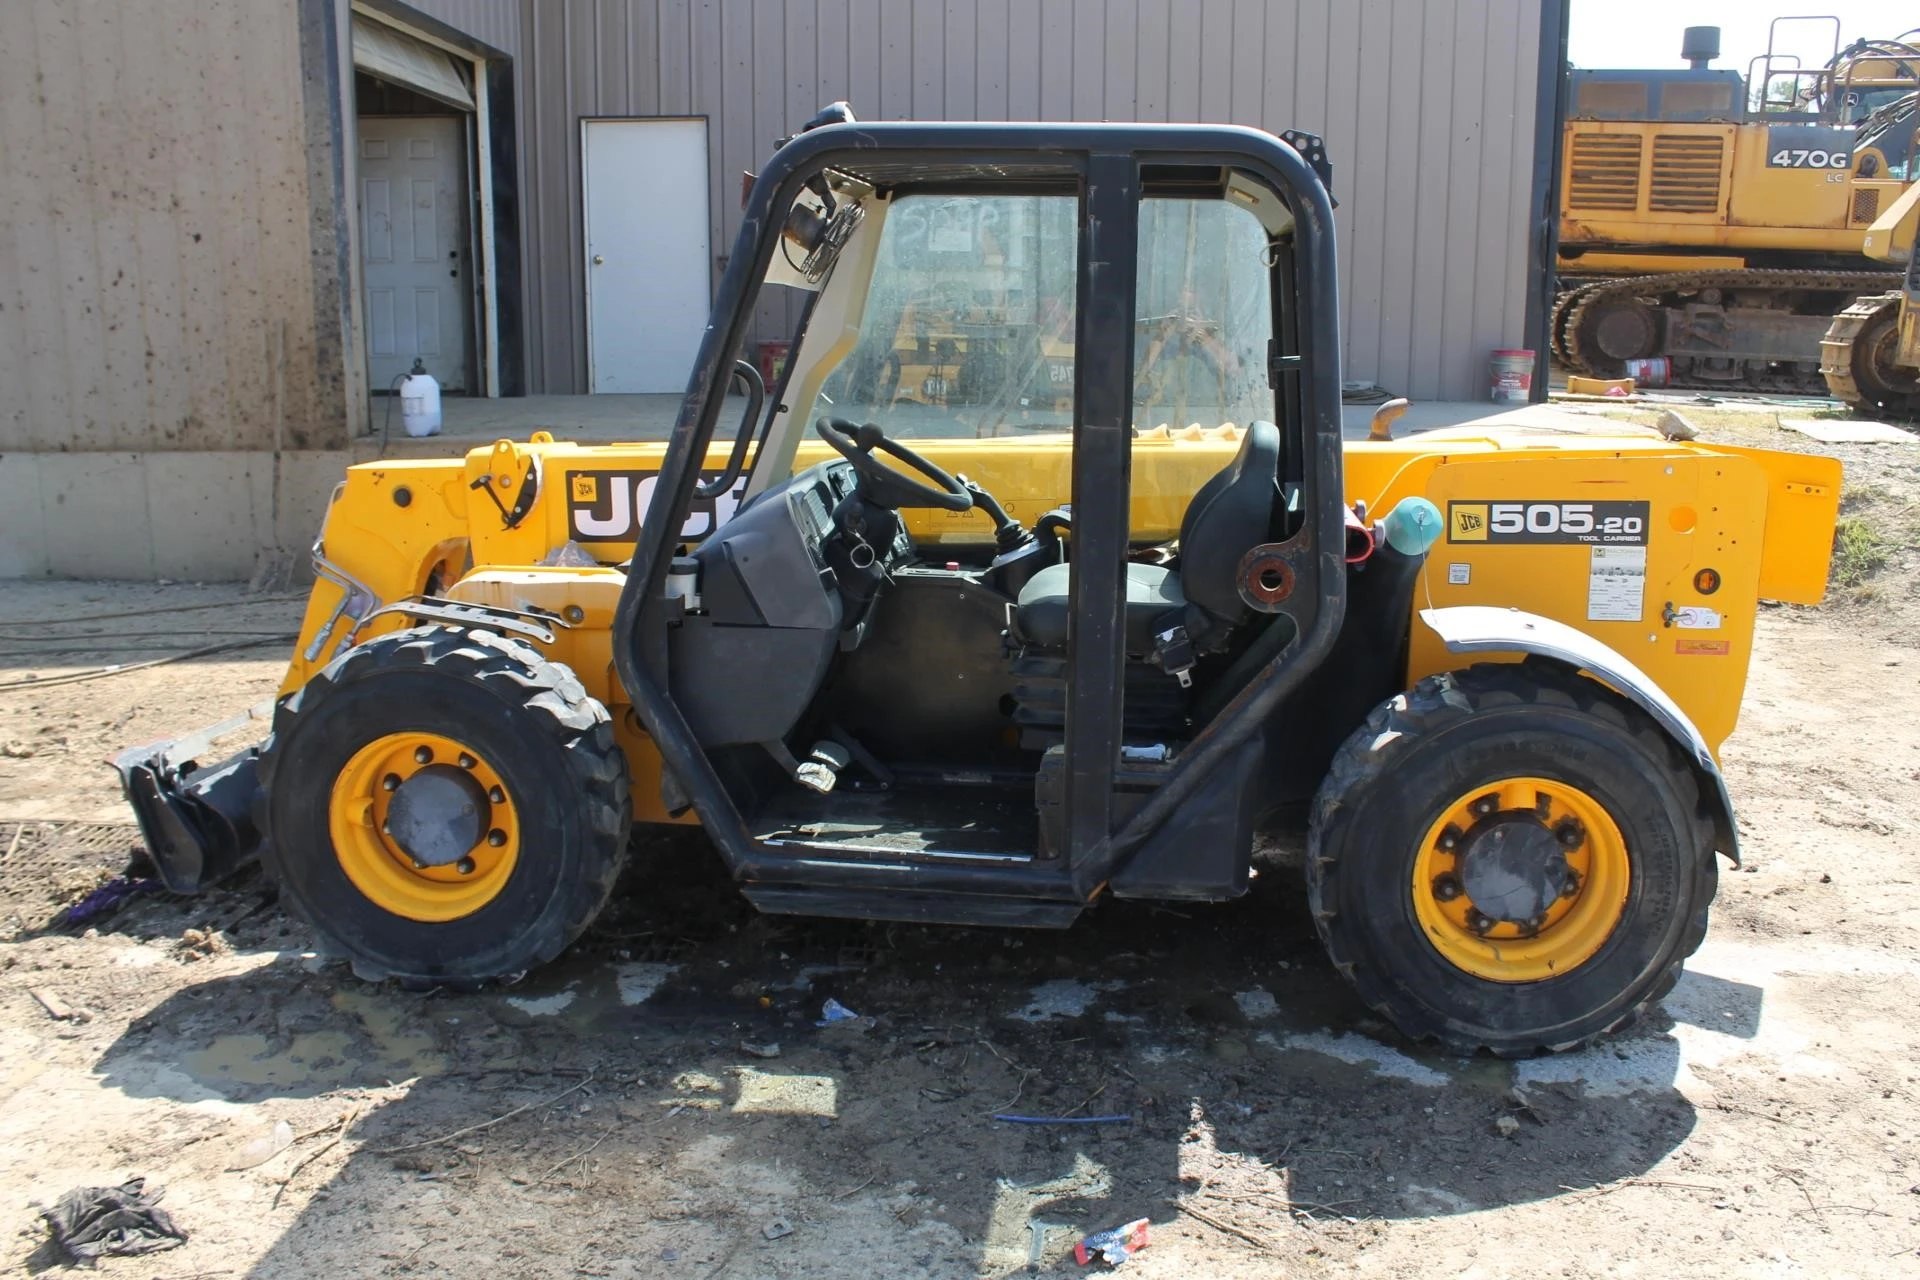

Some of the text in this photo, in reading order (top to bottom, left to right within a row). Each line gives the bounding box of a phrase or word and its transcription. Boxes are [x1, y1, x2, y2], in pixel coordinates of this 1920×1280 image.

[1772, 150, 1846, 168] 470G
[1827, 173, 1844, 182] LC
[1460, 513, 1482, 531] JCB
